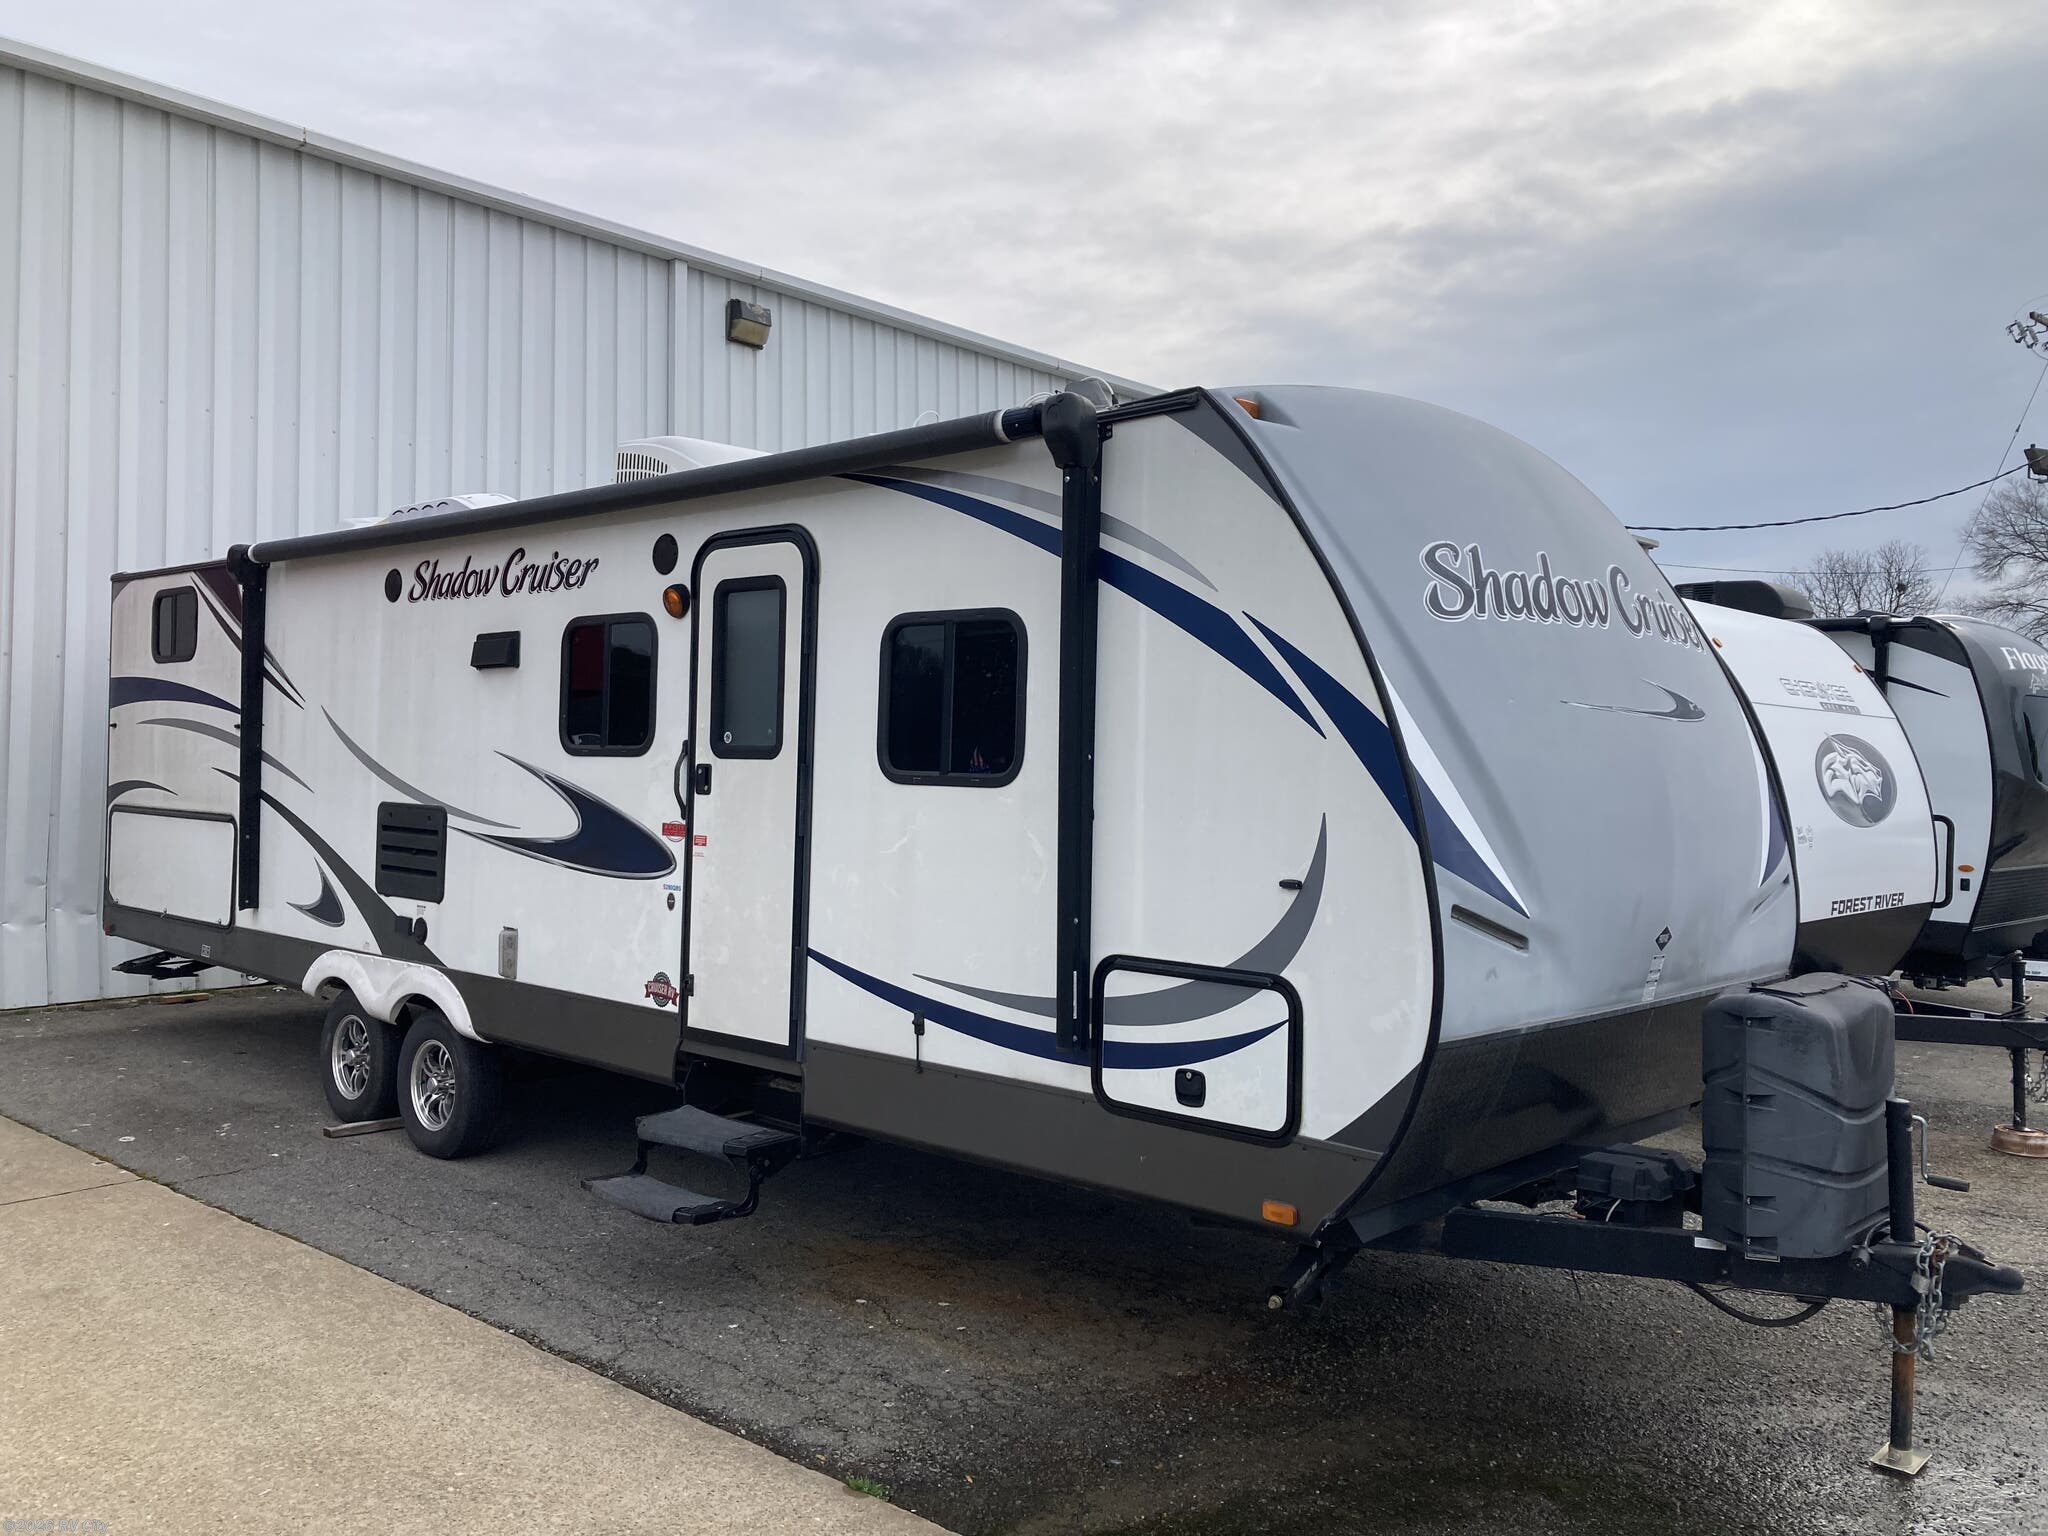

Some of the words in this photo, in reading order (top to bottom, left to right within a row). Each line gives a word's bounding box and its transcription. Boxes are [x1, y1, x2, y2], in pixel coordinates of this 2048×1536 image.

[408, 555, 499, 603] Shadow
[500, 547, 599, 598] Cruiser
[1419, 541, 1609, 629] Shadow
[1831, 896, 1873, 916] FOREST
[1875, 892, 1904, 909] RIVER
